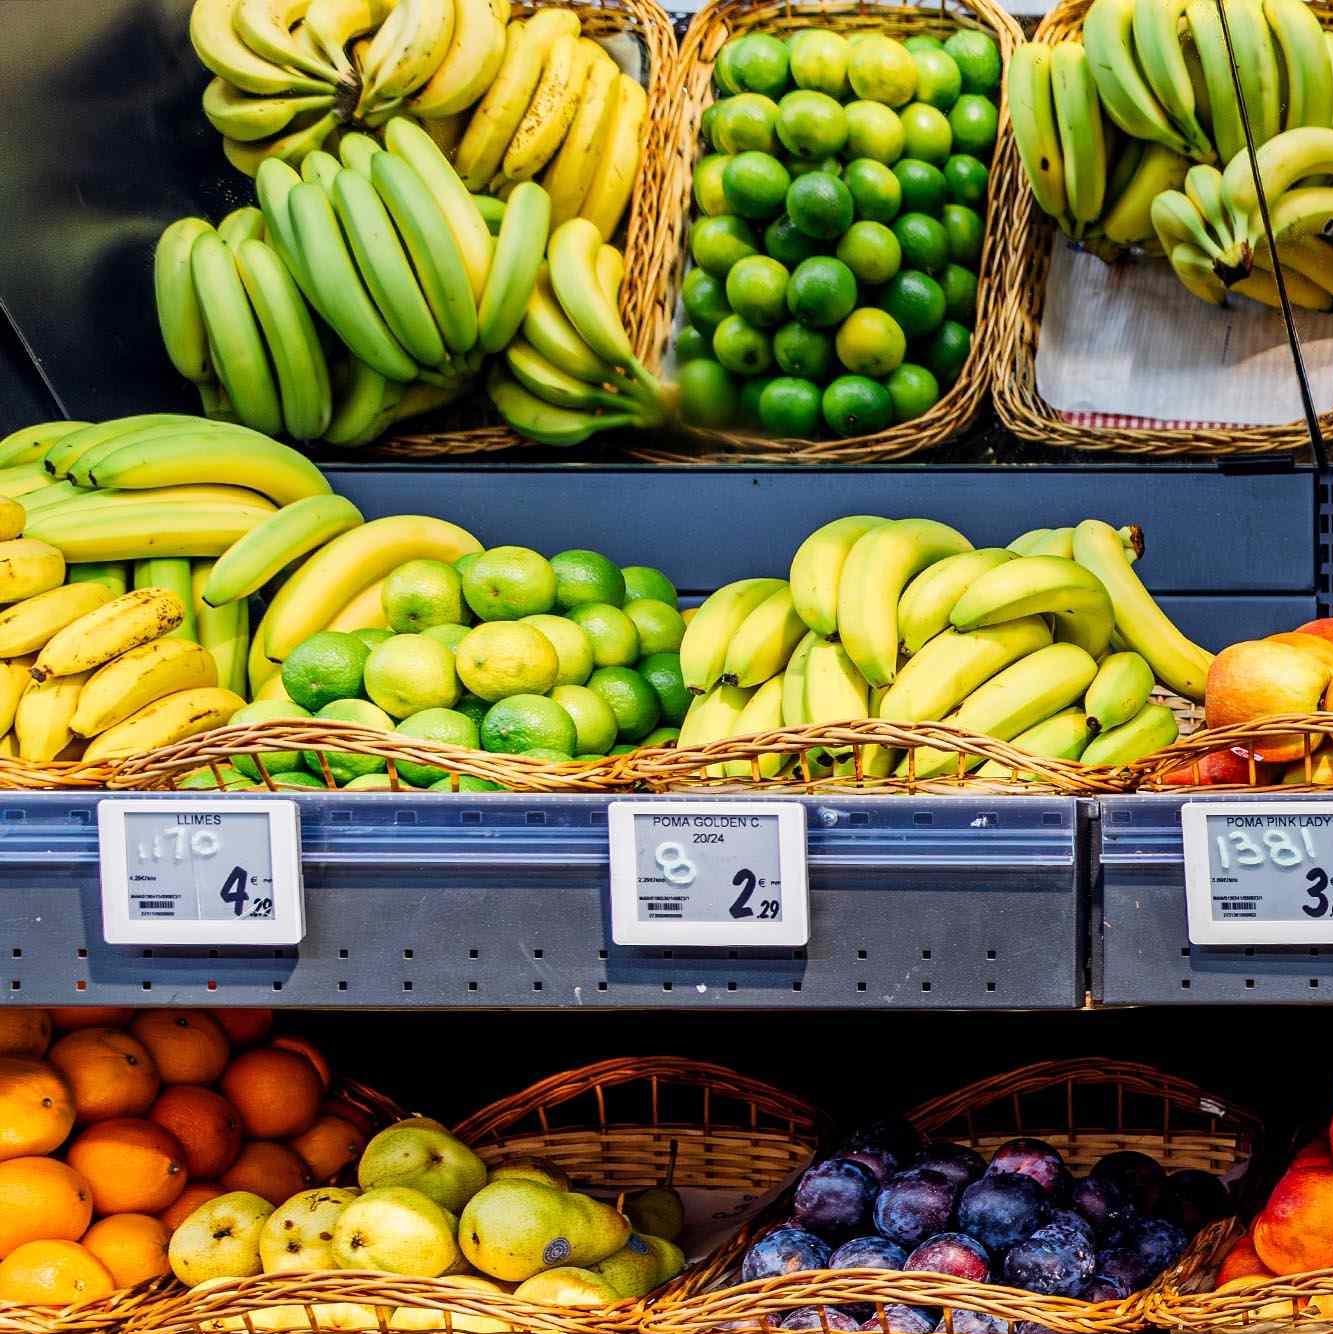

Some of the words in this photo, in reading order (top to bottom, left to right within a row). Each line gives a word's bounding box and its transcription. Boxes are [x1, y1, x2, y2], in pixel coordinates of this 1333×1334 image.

[177, 814, 222, 825] LLIMES
[653, 816, 690, 828] POMA
[693, 816, 748, 828] GOLDEN
[750, 816, 763, 828] C.
[1226, 816, 1264, 828] POMA
[1267, 816, 1296, 828] PINK
[1299, 816, 1332, 828] LADY
[693, 833, 725, 844] 20/24
[655, 841, 698, 885] 8
